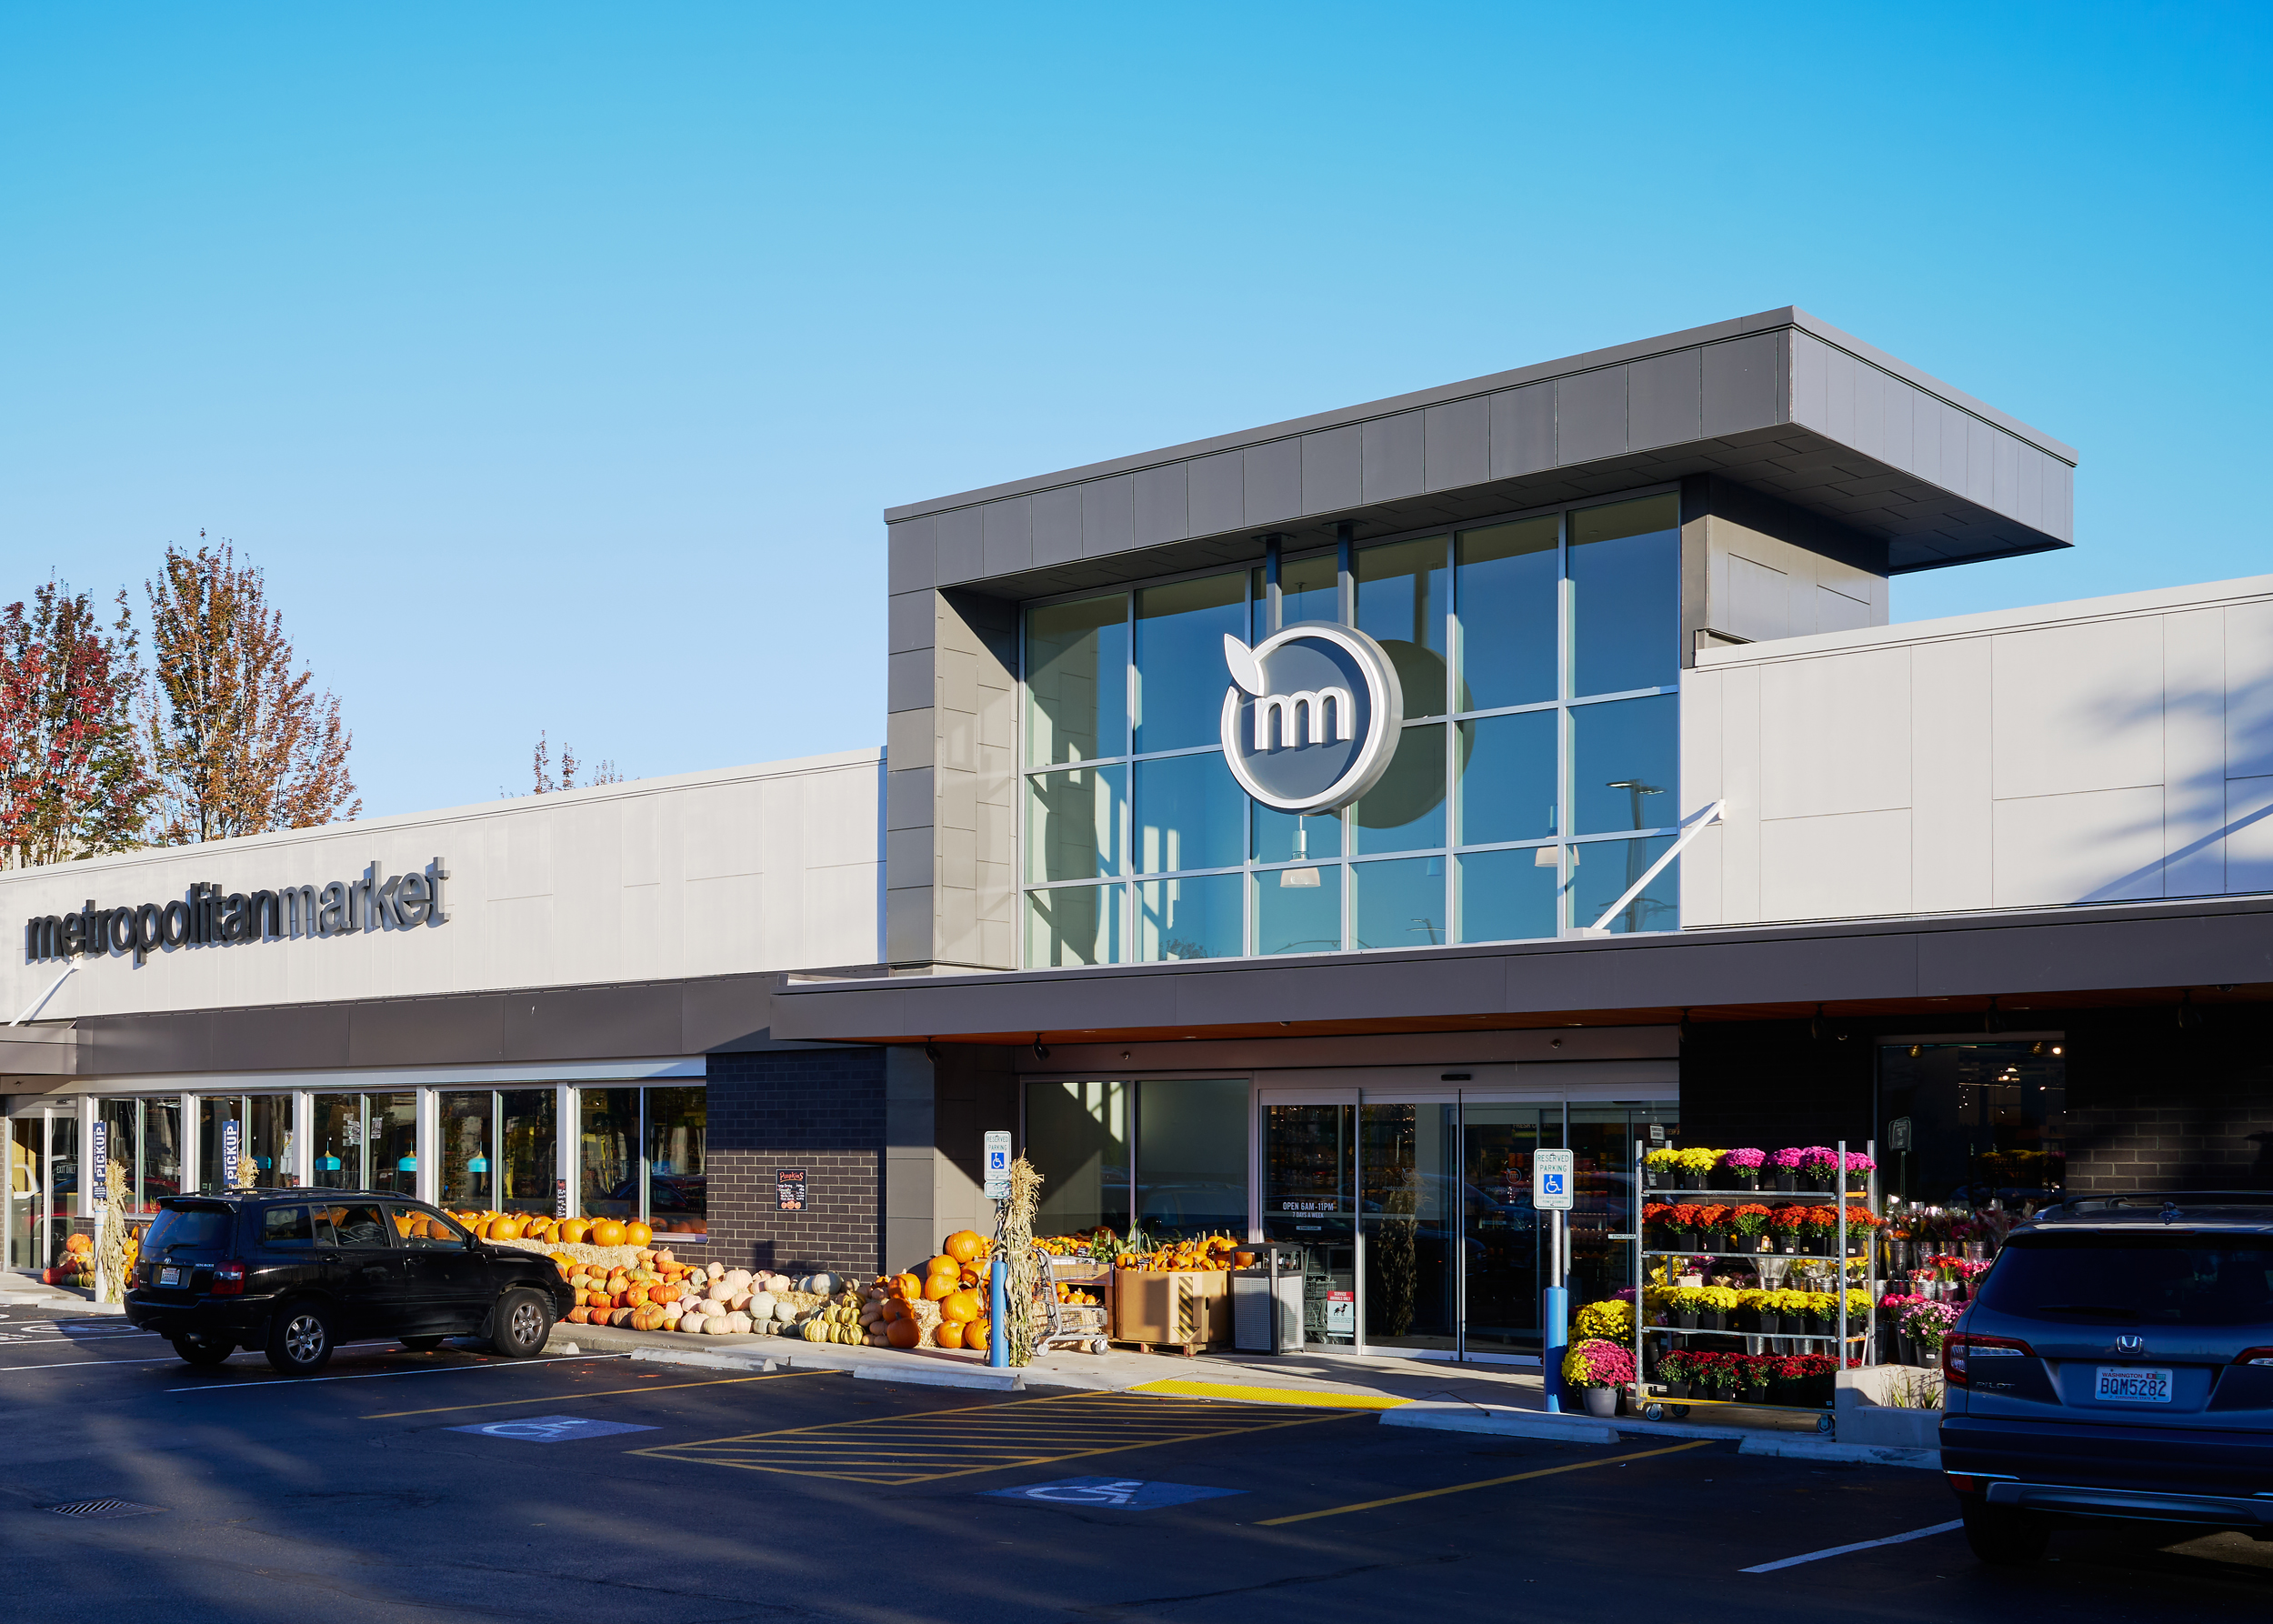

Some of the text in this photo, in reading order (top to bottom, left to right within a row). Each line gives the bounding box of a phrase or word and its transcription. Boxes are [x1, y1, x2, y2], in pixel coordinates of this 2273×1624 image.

[95, 1127, 105, 1178] PICKUP
[226, 1126, 237, 1180] PICKUP
[1537, 1154, 1569, 1162] RESERVED
[1539, 1164, 1567, 1172] PARKING
[1282, 1201, 1299, 1210] OPEN
[1976, 1381, 2016, 1389] PILOT
[2100, 1378, 2167, 1398] BQM5282
